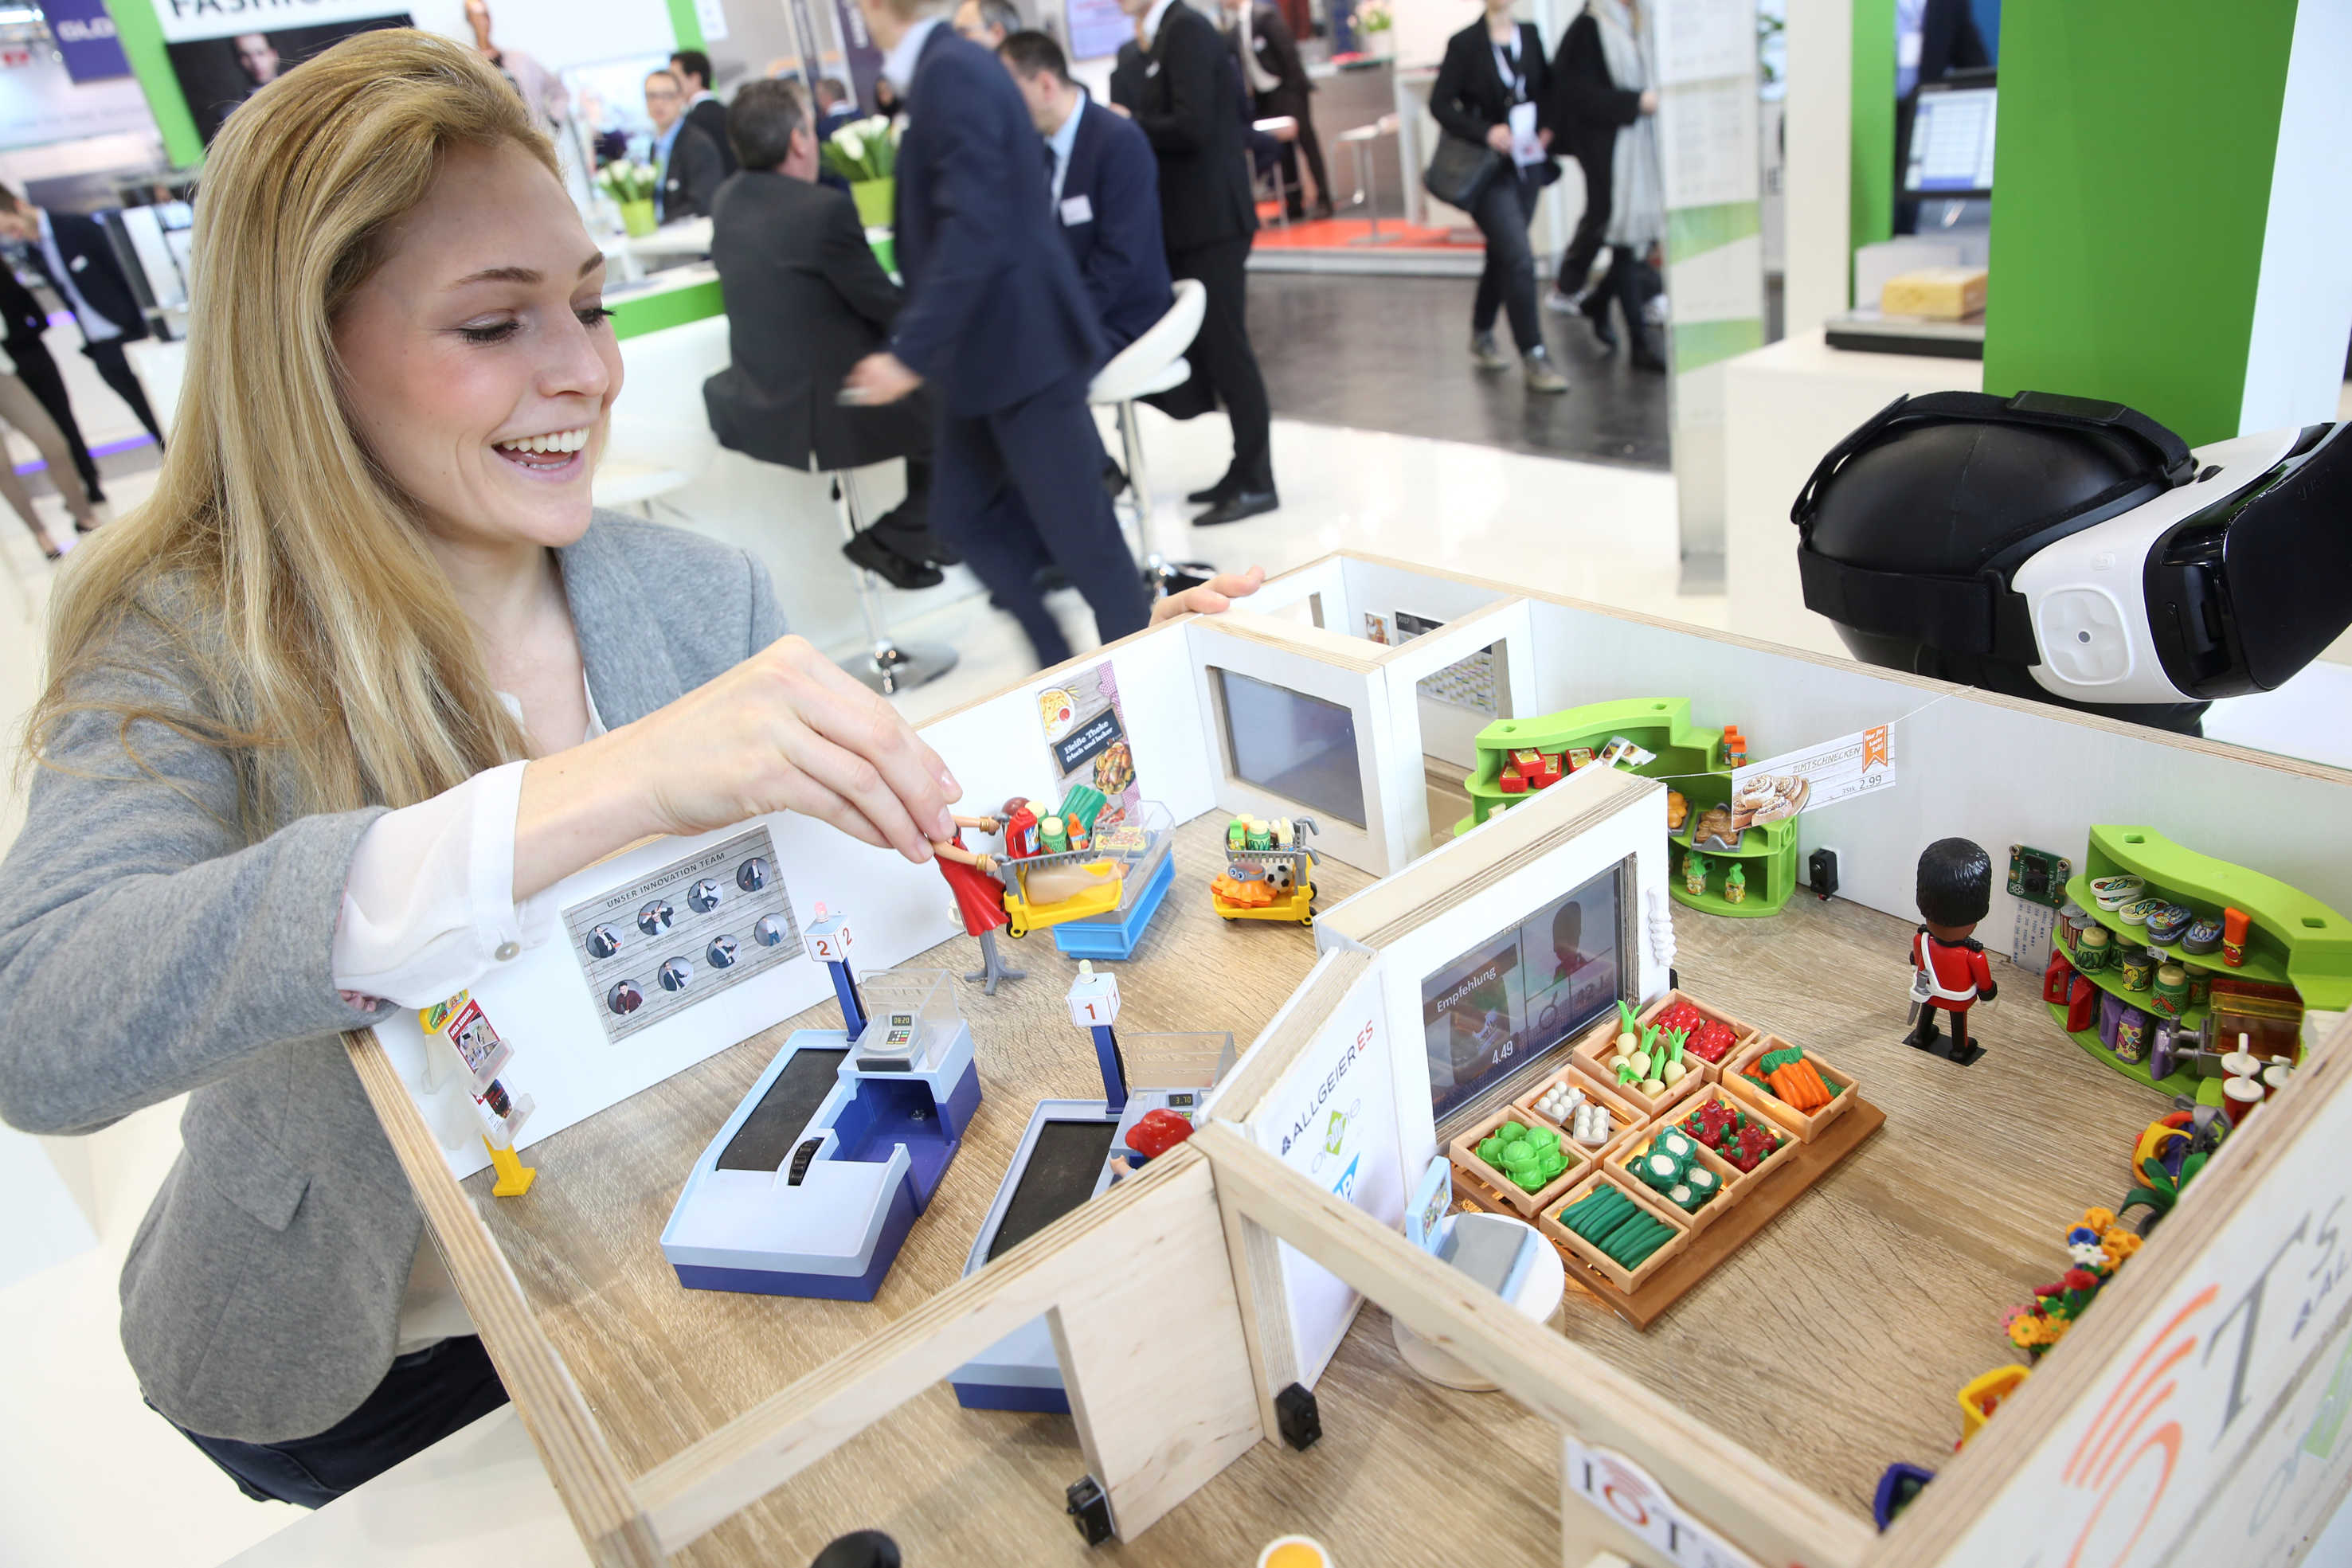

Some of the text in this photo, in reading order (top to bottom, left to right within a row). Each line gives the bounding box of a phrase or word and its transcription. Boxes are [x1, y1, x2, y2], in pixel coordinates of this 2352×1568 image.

[1064, 736, 1086, 754] Heiße
[1086, 721, 1109, 739] Theke
[1066, 748, 1084, 763] frisch
[1083, 739, 1096, 750] und
[1095, 727, 1113, 742] lecker
[1792, 746, 1861, 773] ZIMTSCHNECKEN
[1860, 775, 1881, 790] 2.99
[607, 852, 726, 908] UNSER INNOVATION TEAM
[816, 940, 830, 956] 2
[843, 927, 852, 945] 2
[1437, 966, 1497, 1013] Empfehlung
[1085, 1003, 1096, 1019] 1
[1492, 1040, 1513, 1065] 4.49
